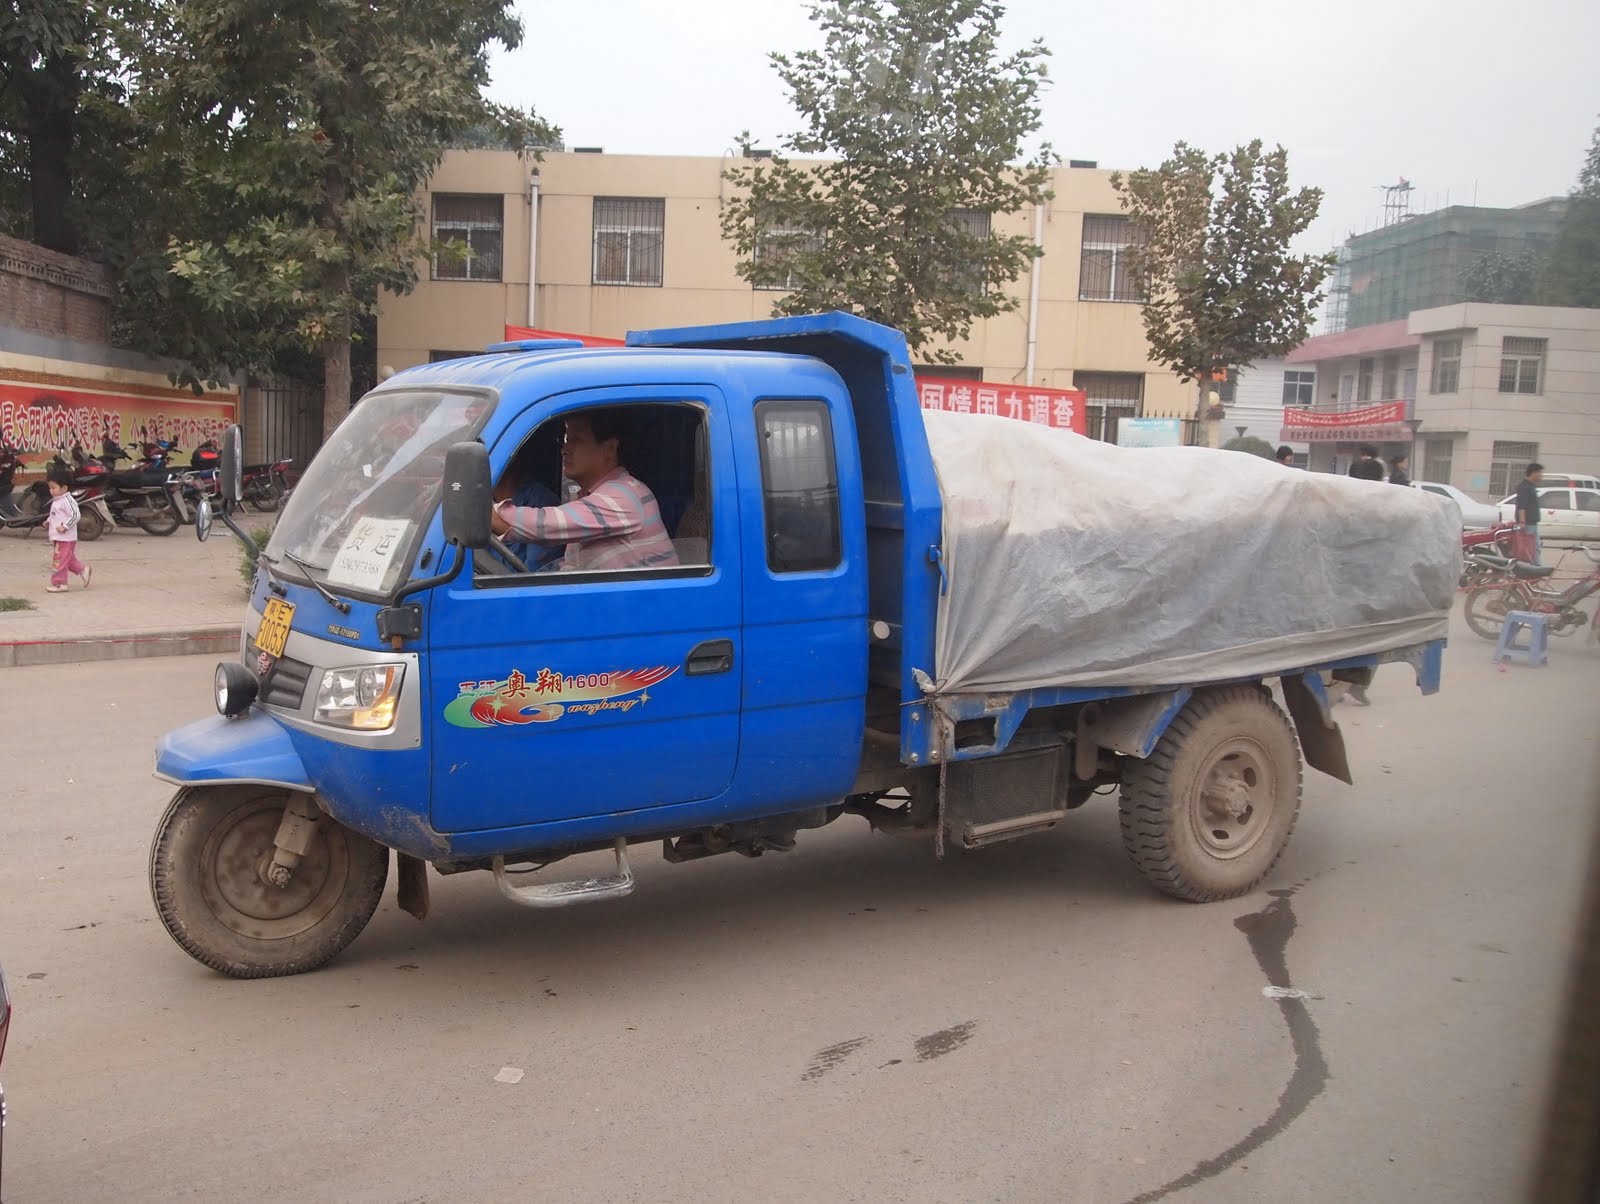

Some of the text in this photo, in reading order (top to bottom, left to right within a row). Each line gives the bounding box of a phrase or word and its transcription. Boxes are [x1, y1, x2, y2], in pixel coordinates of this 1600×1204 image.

[921, 383, 1074, 432] 国情国力调查
[346, 522, 399, 556] 货运
[501, 667, 563, 698] 奥翔
[565, 672, 610, 690] 1600
